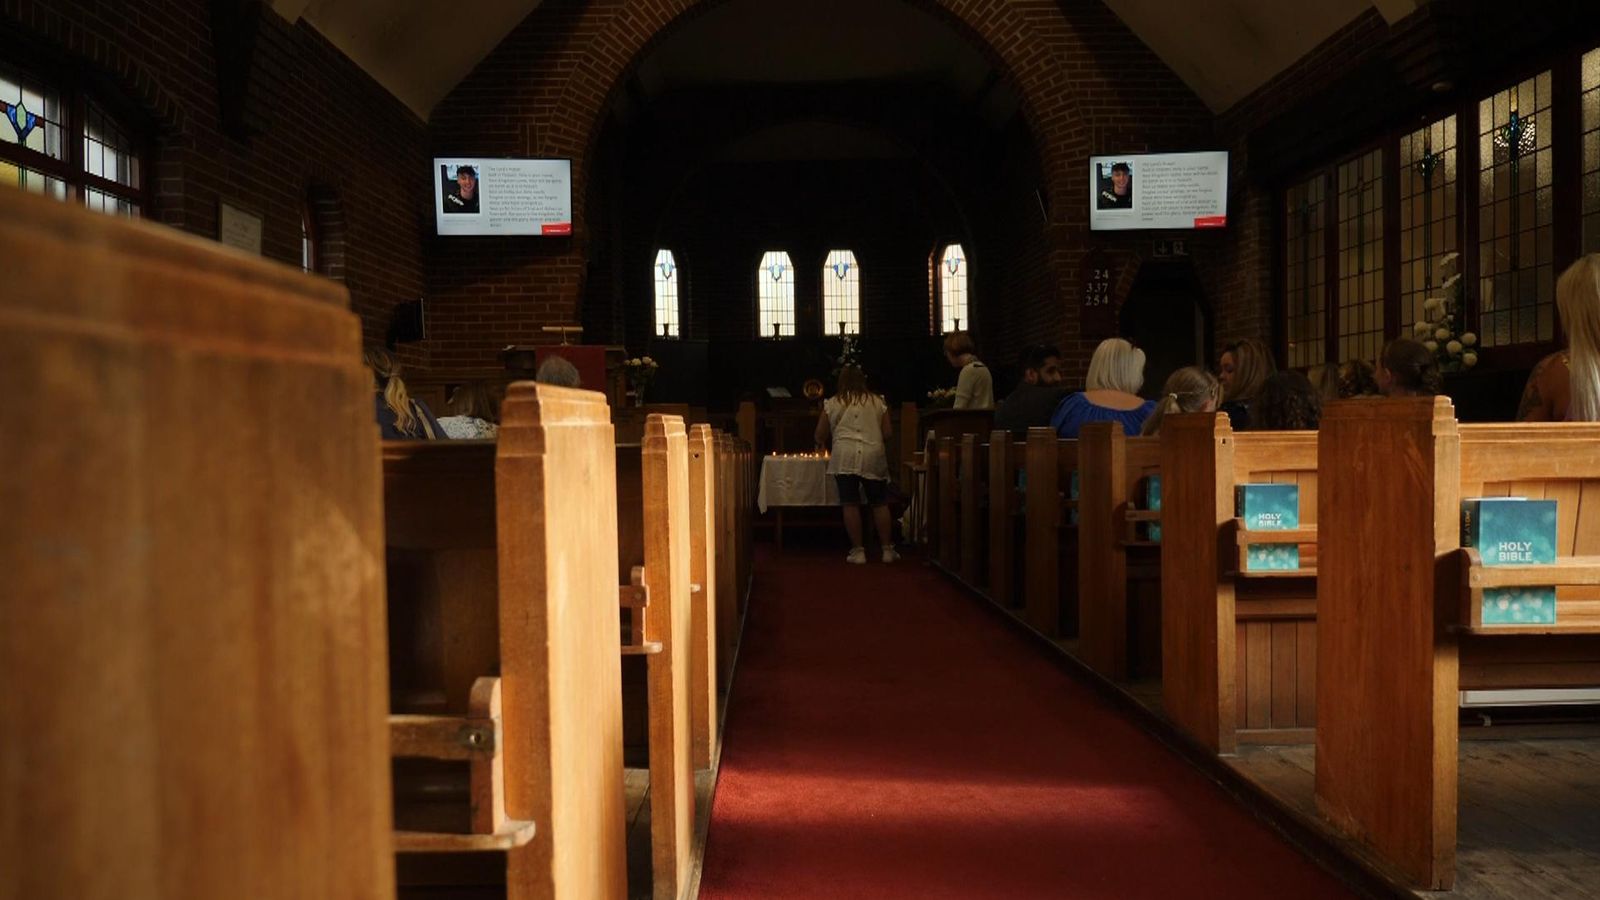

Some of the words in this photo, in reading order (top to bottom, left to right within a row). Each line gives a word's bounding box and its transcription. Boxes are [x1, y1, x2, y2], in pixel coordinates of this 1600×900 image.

[1094, 269, 1109, 280] 24
[1086, 282, 1109, 293] 337
[1085, 294, 1109, 306] 254
[1498, 541, 1533, 551] HOLY
[1498, 551, 1533, 562] BIBLE
